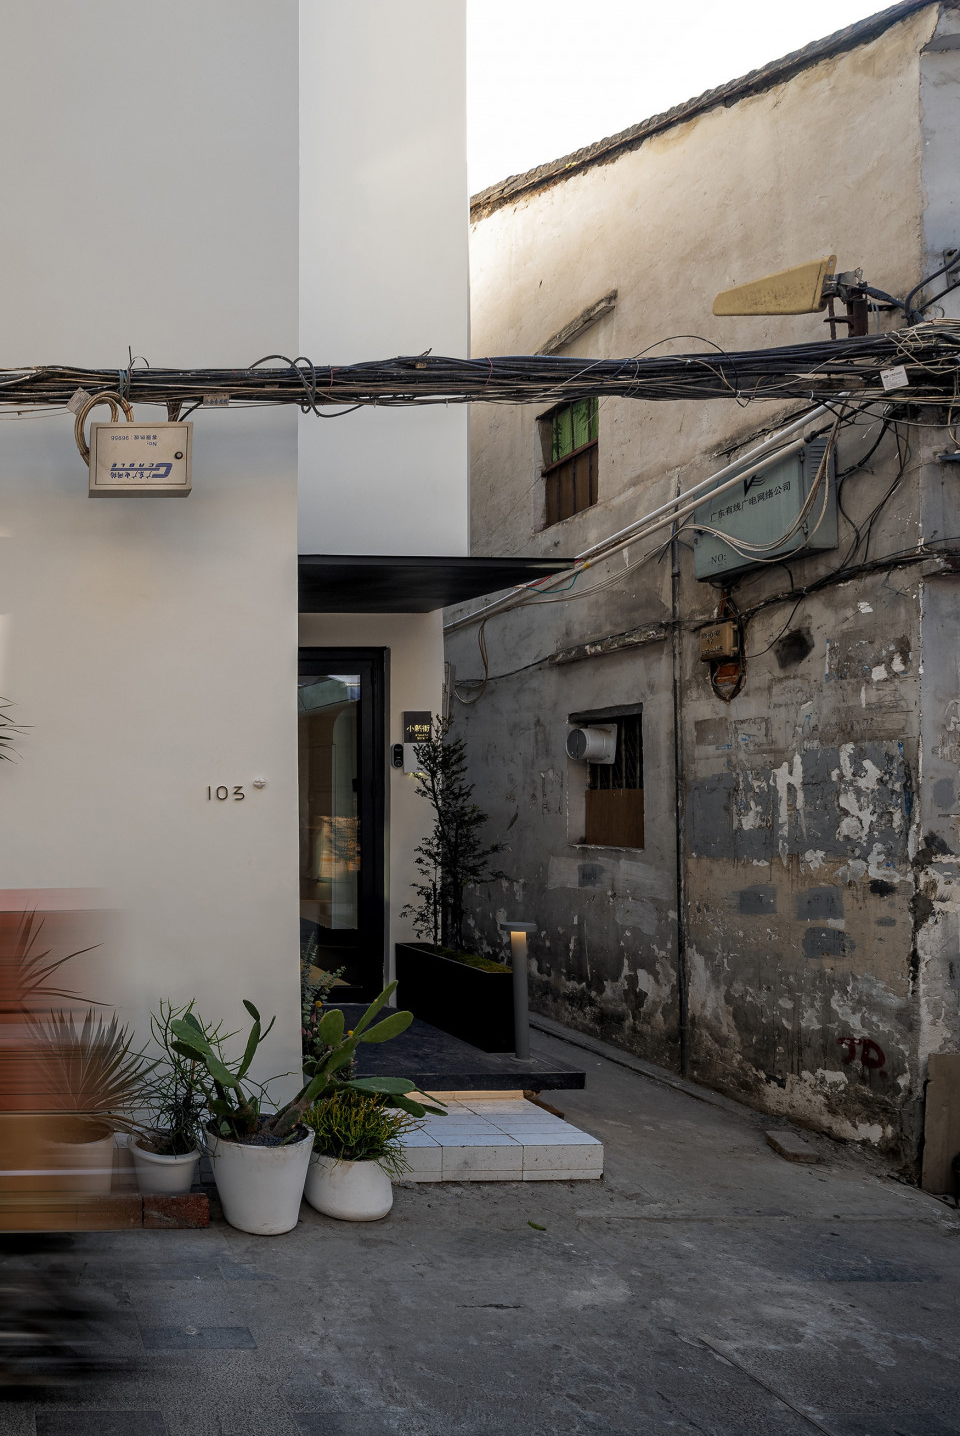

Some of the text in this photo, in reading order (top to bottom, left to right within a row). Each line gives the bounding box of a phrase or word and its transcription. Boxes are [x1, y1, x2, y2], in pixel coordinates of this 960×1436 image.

[710, 481, 791, 522] 广东有线广电网络公司
[208, 785, 245, 801] 103
